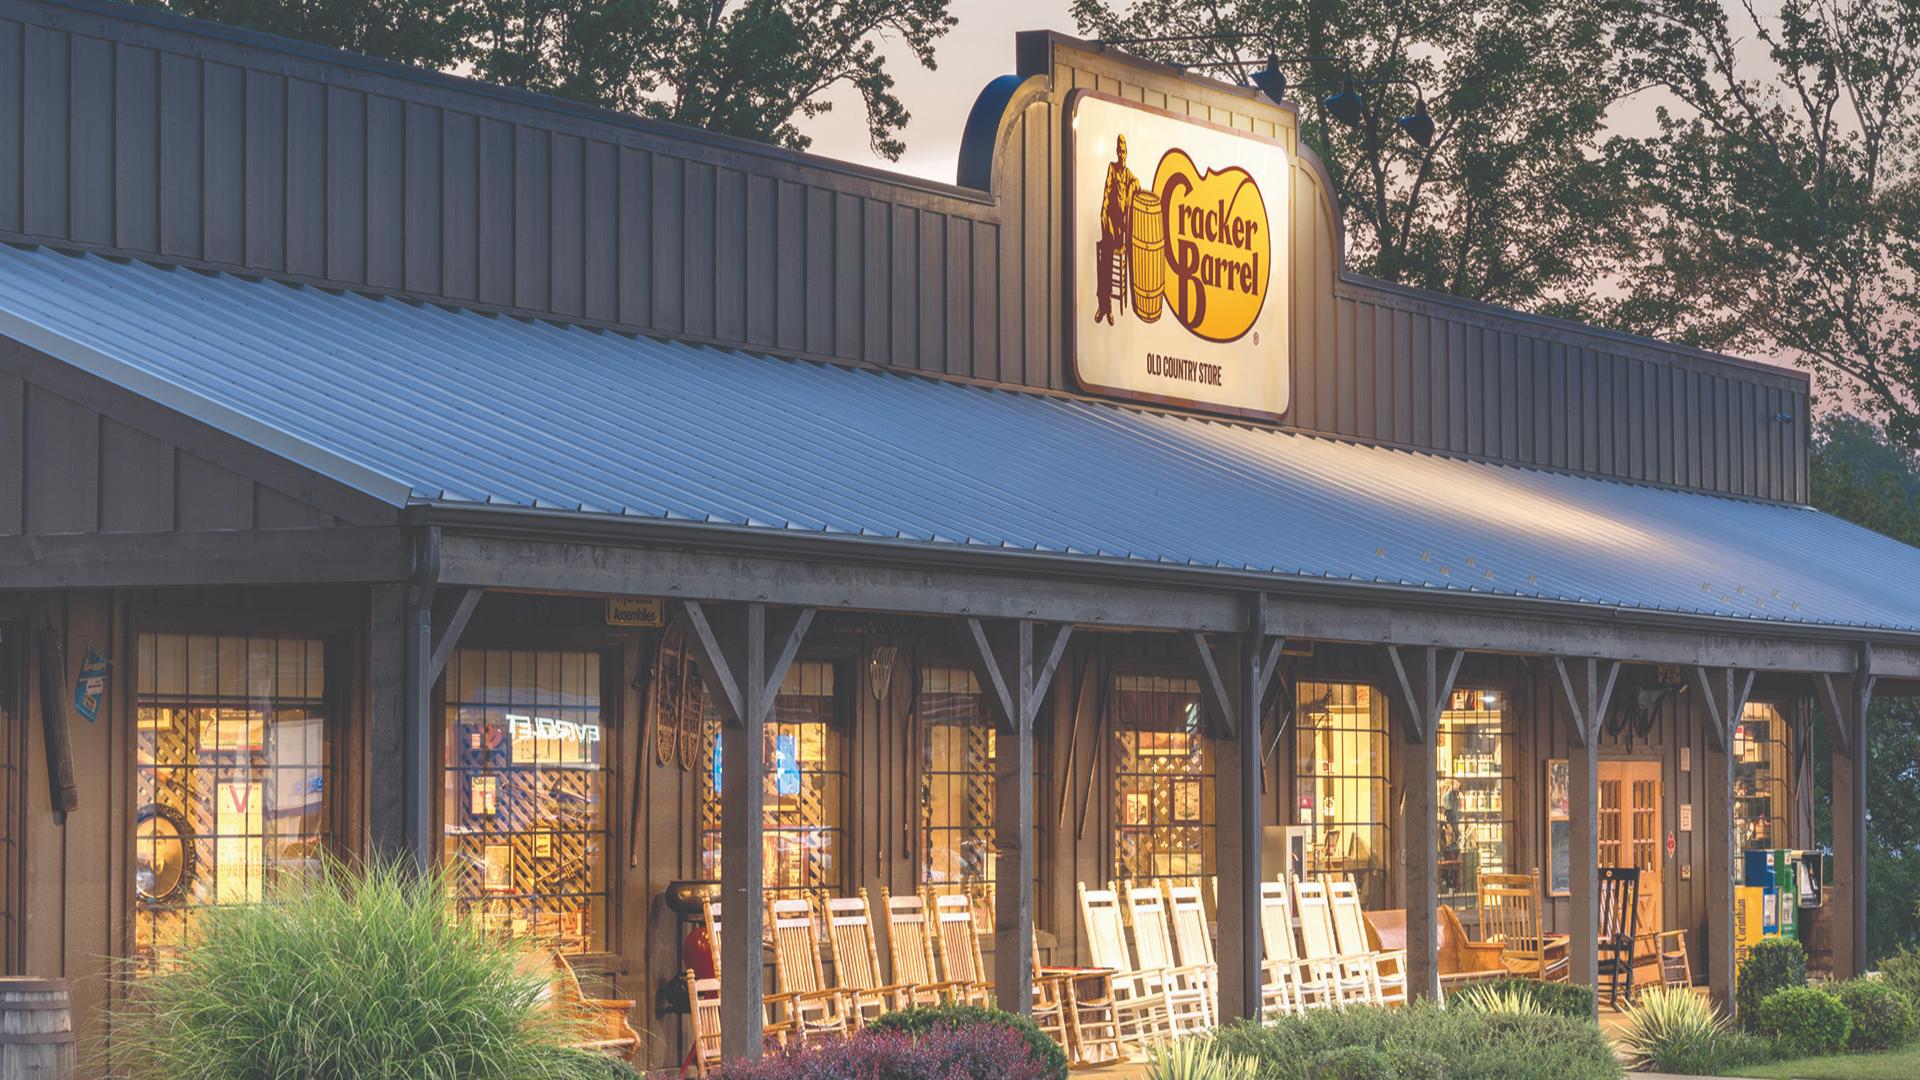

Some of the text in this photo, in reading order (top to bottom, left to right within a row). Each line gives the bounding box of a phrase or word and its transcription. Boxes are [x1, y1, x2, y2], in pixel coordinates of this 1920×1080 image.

[1162, 172, 1258, 276] Cracker
[1177, 239, 1258, 330] Barrel
[1147, 353, 1222, 386] OLD COUNTRY STORE
[1735, 898, 1747, 941] Corinthian
